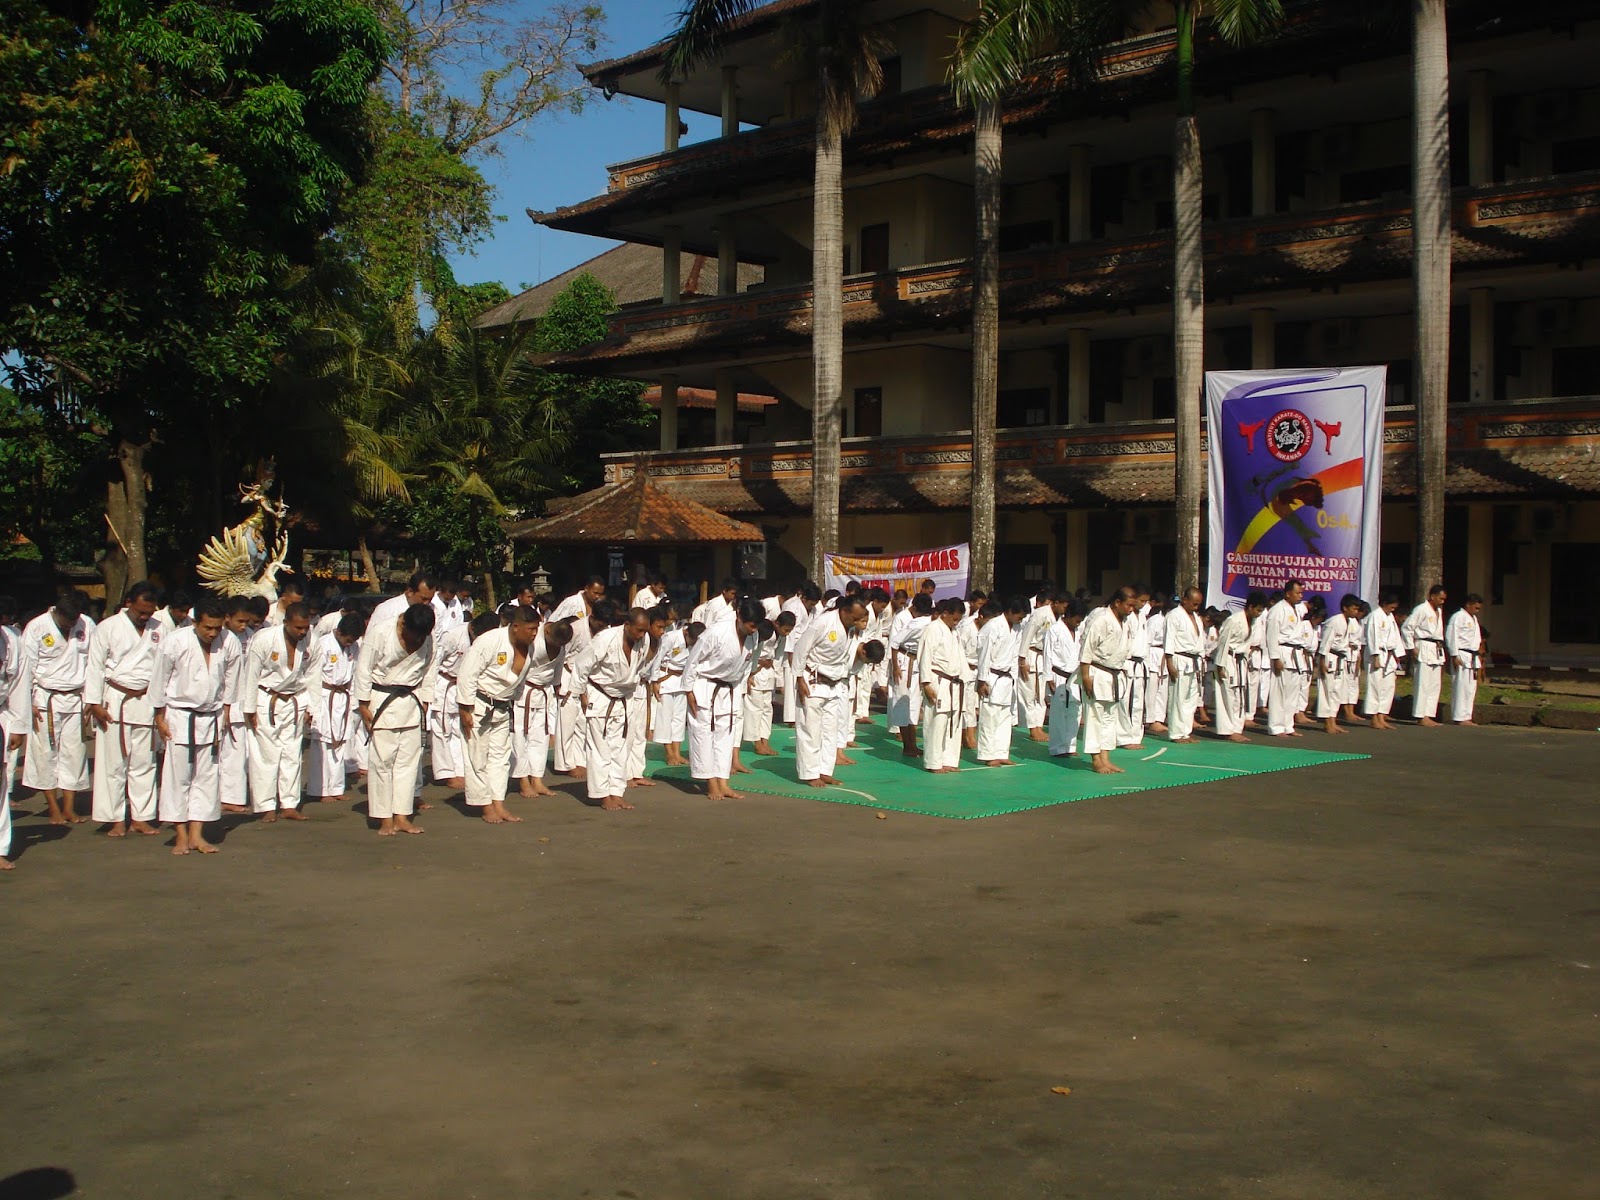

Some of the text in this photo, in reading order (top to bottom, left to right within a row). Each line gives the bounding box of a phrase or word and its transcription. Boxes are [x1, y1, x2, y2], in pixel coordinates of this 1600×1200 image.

[1276, 450, 1302, 460] INKANAS
[897, 549, 960, 573] INKANAS
[1328, 557, 1359, 569] DAN
[1227, 564, 1357, 581] KEGIATAN NASIONAL
